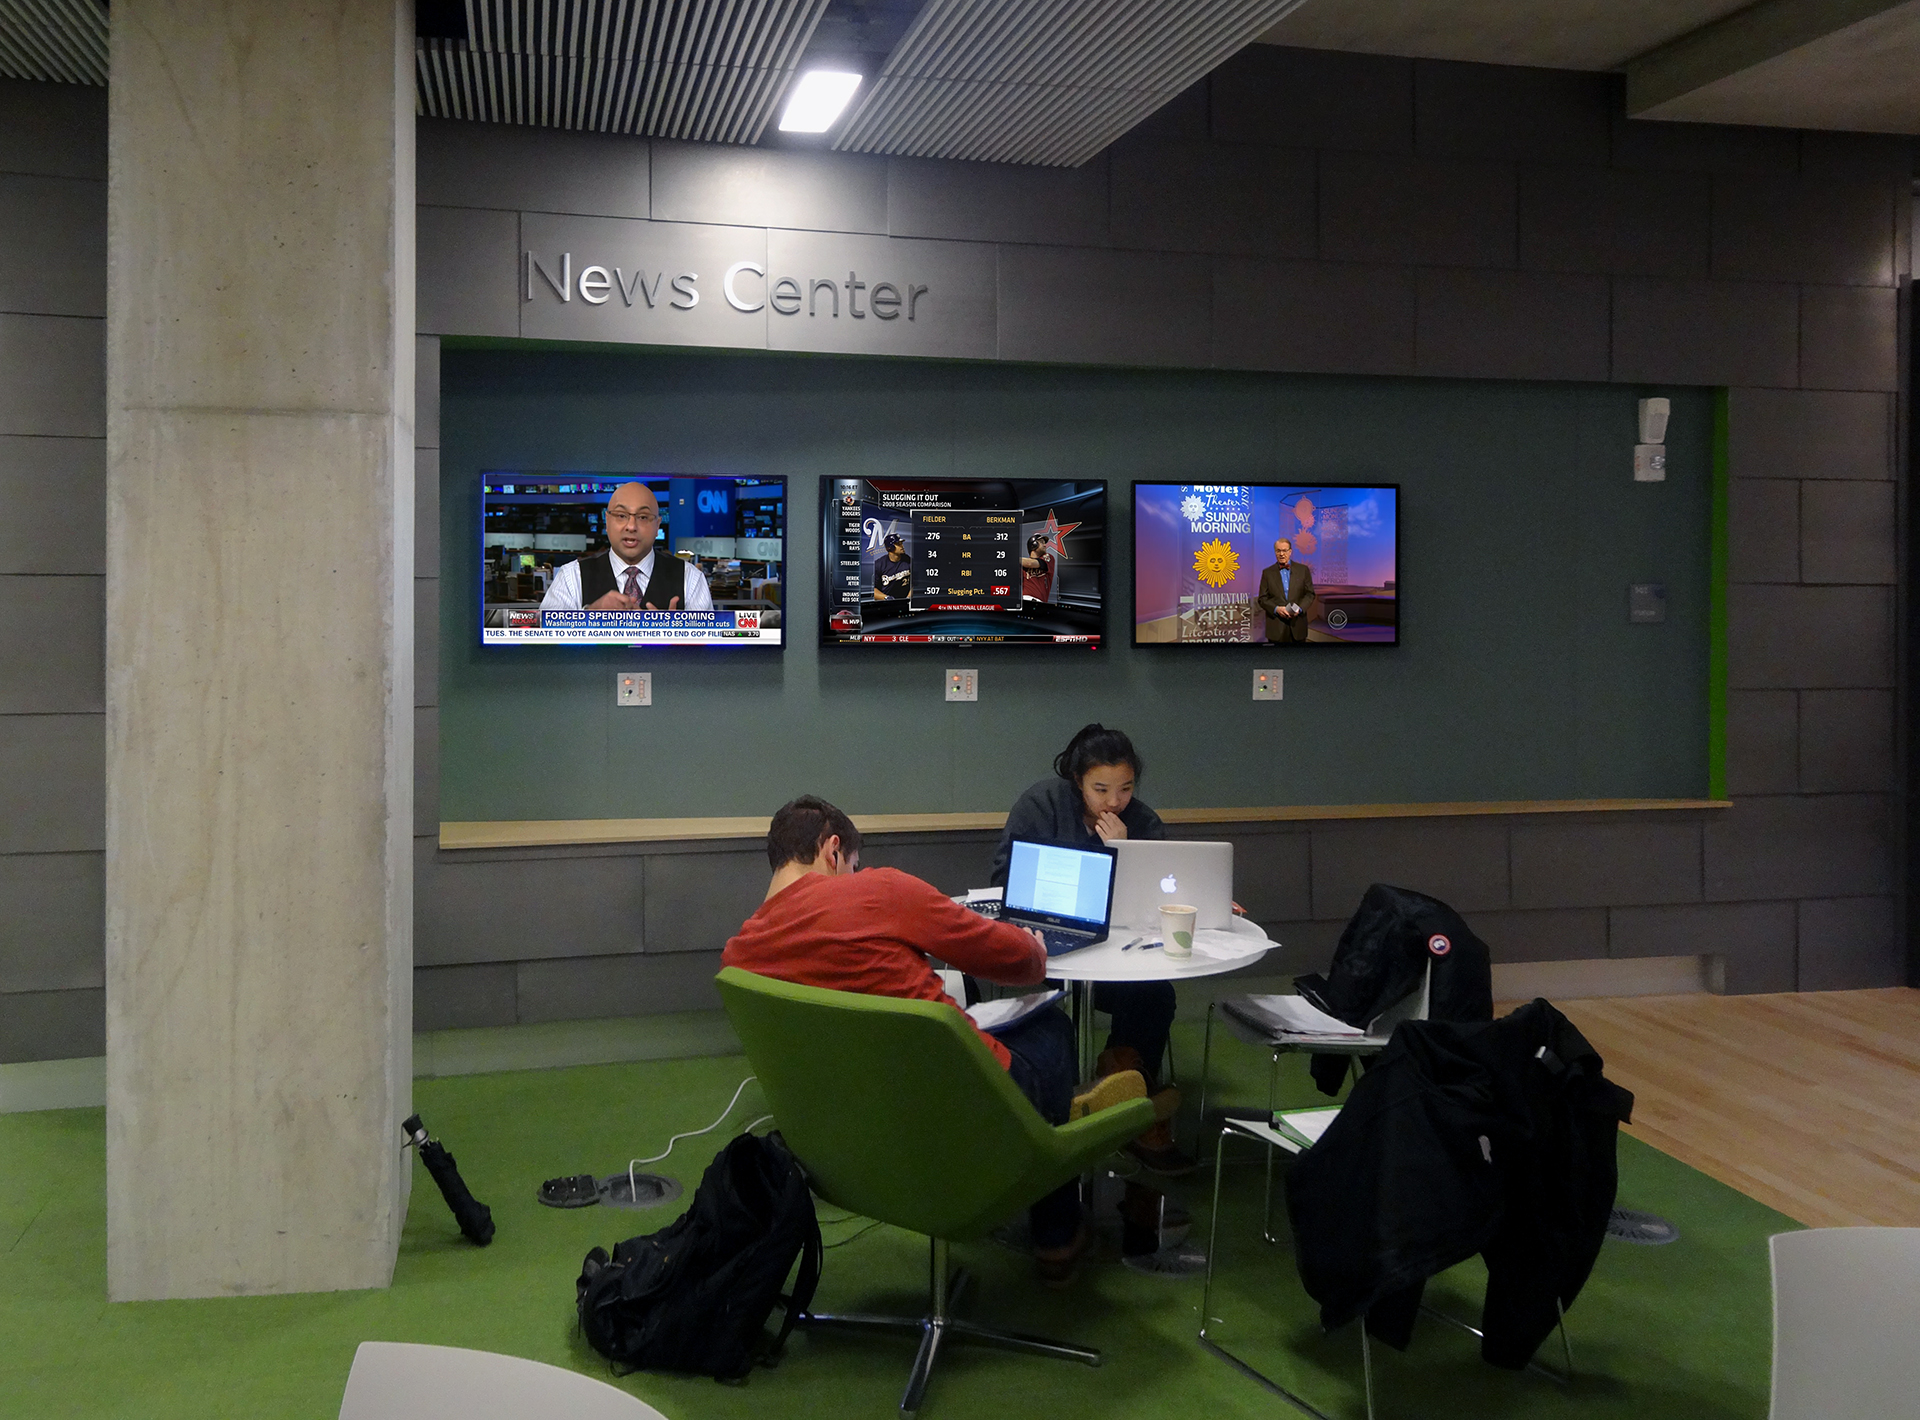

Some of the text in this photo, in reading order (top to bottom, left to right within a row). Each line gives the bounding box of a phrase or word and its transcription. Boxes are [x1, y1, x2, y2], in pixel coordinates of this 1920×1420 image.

[528, 250, 928, 321] News Center
[697, 491, 728, 514] CNN
[1206, 512, 1250, 522] SUNDAY
[1191, 522, 1250, 534] MORNING
[948, 588, 972, 596] Slugging
[992, 587, 1008, 595] .567
[1198, 592, 1250, 604] COMMENTARY
[588, 612, 640, 620] SPENDING
[1199, 609, 1237, 621] ART
[546, 620, 586, 628] Washington
[619, 620, 640, 628] Friday
[738, 618, 758, 628] CNN
[1182, 625, 1238, 638] Literature
